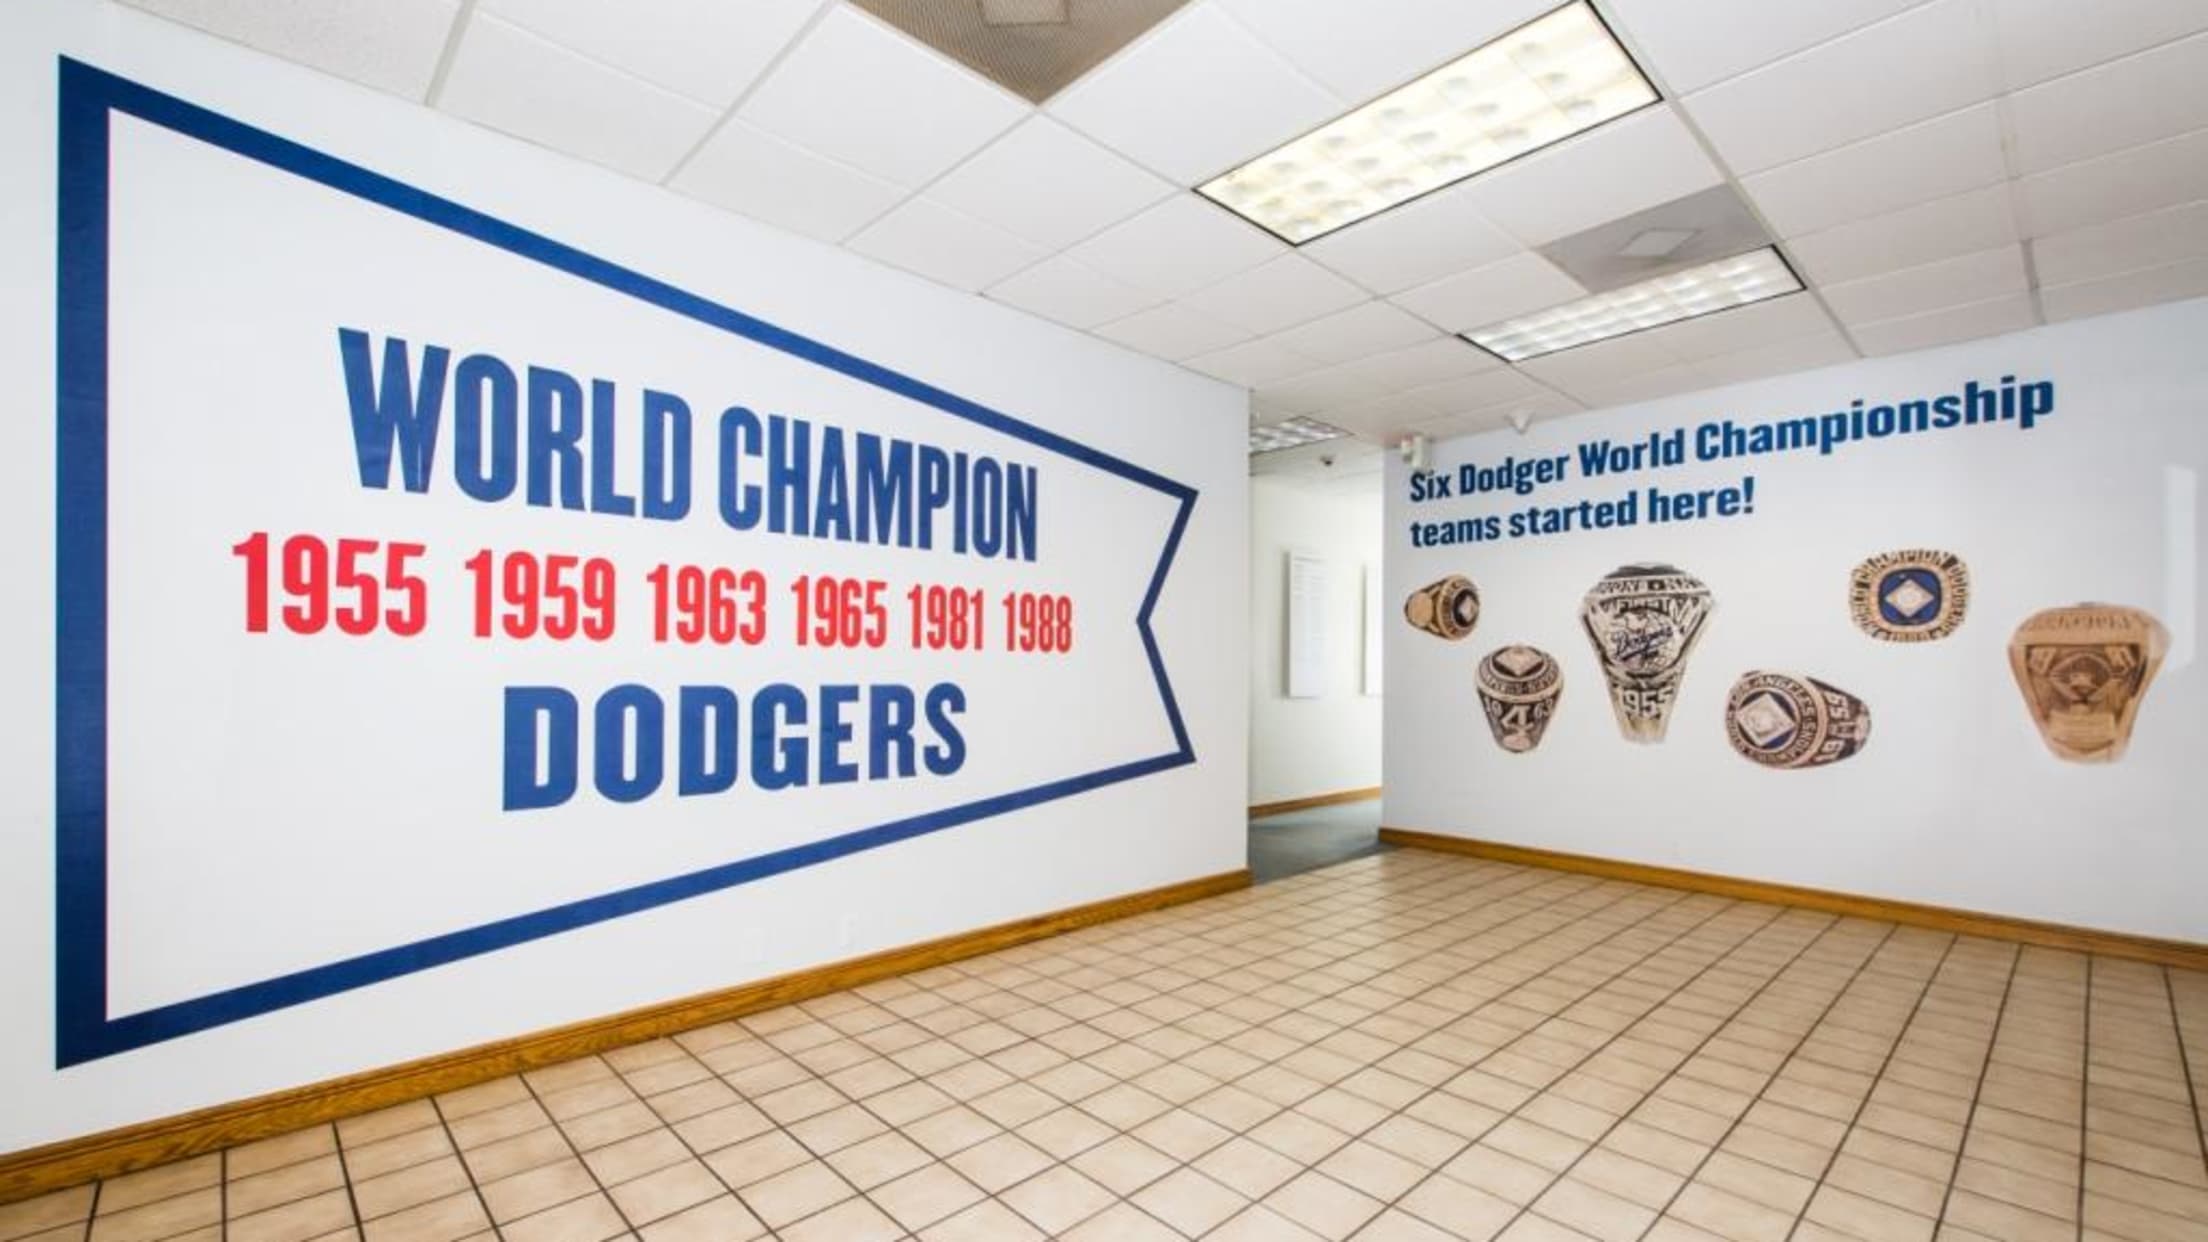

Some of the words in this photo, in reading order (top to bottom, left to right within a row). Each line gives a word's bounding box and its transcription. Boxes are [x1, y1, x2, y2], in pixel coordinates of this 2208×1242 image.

[338, 327, 692, 522] WORLD
[718, 406, 1038, 562] CHAMPION
[1409, 472, 1451, 502] Six
[1460, 456, 1570, 495] Dodger
[1578, 429, 1685, 476] World
[1695, 375, 2055, 461] Championship
[1409, 516, 1501, 547] teams
[1508, 493, 1638, 537] started
[1648, 477, 1755, 522] here!
[231, 531, 429, 639] 1955
[464, 548, 618, 643] 1959
[645, 564, 768, 647] 1963
[790, 574, 889, 650] 1965
[907, 583, 985, 652] 1981
[1002, 591, 1073, 654] 1988
[502, 683, 967, 812] DODGERS
